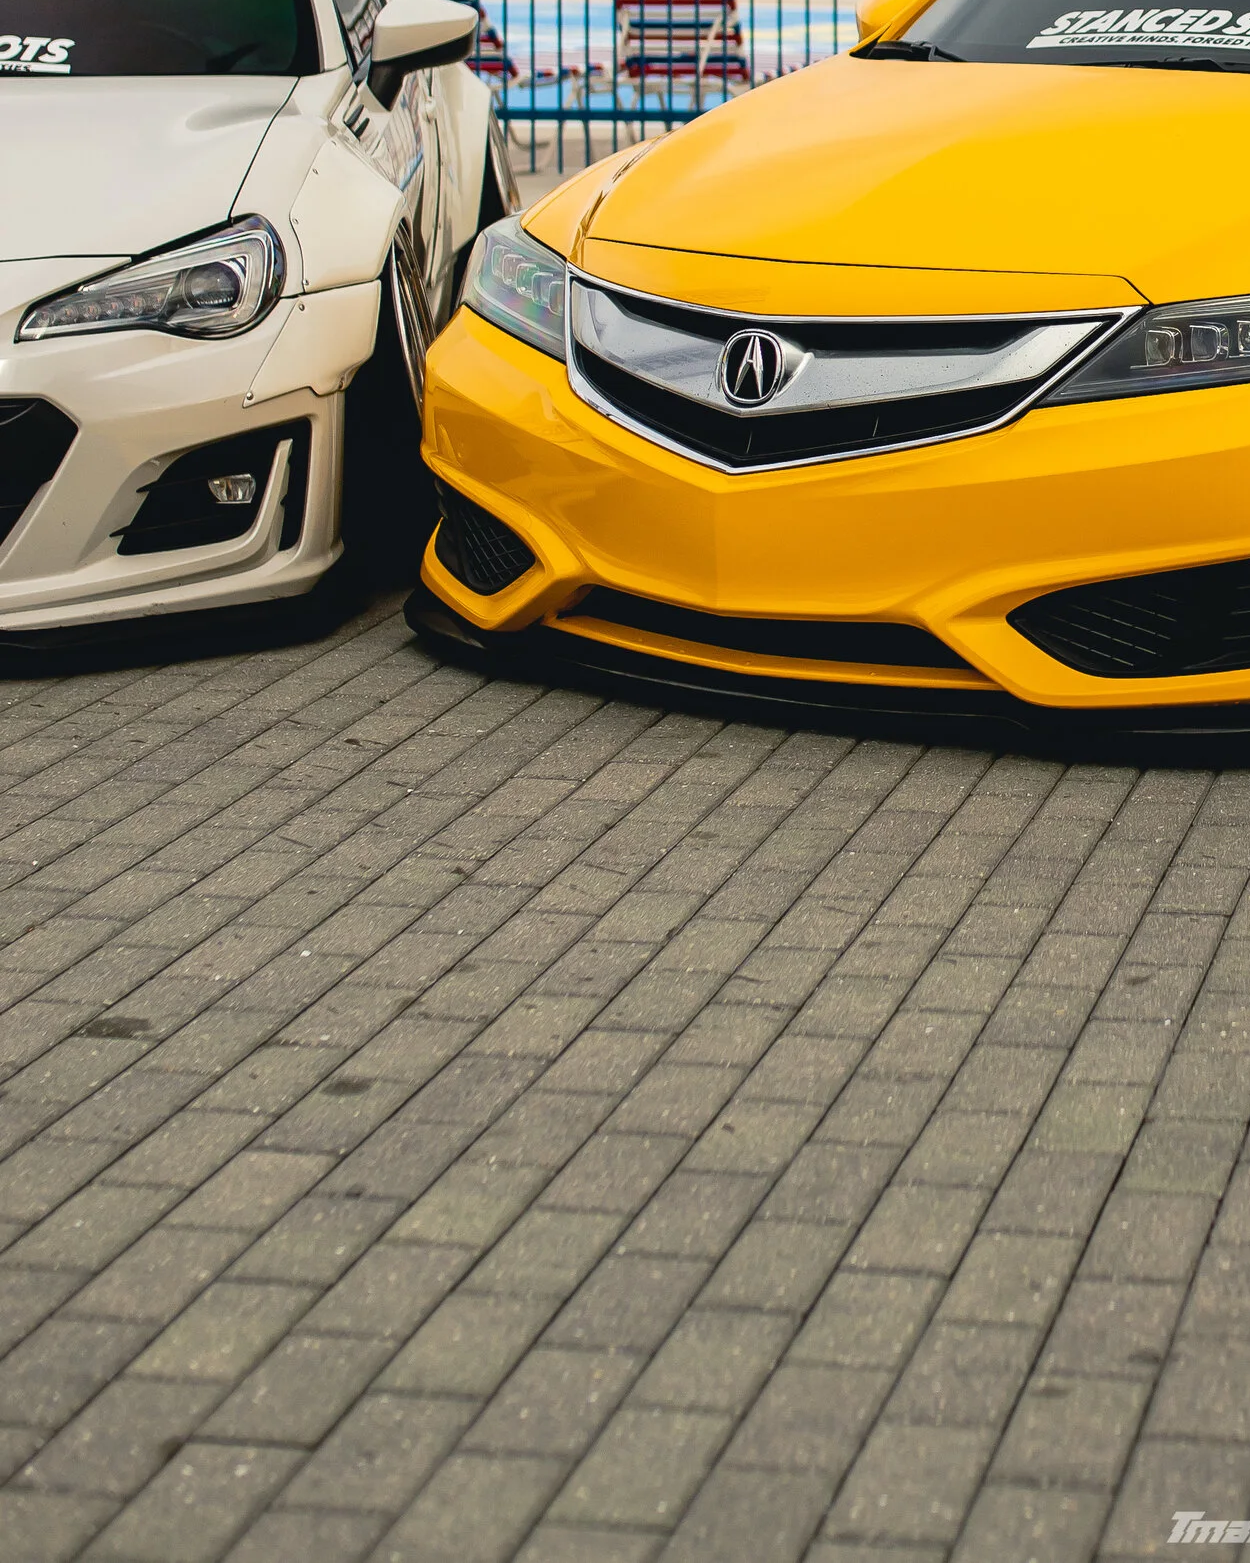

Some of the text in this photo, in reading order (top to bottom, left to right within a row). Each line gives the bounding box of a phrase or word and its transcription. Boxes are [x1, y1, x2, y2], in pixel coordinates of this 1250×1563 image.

[1040, 9, 1232, 35] STANCED
[0, 34, 76, 64] OTS
[1058, 35, 1127, 44] CREATIVE
[1126, 35, 1179, 43] MINDS.
[1182, 36, 1246, 46] FORGED
